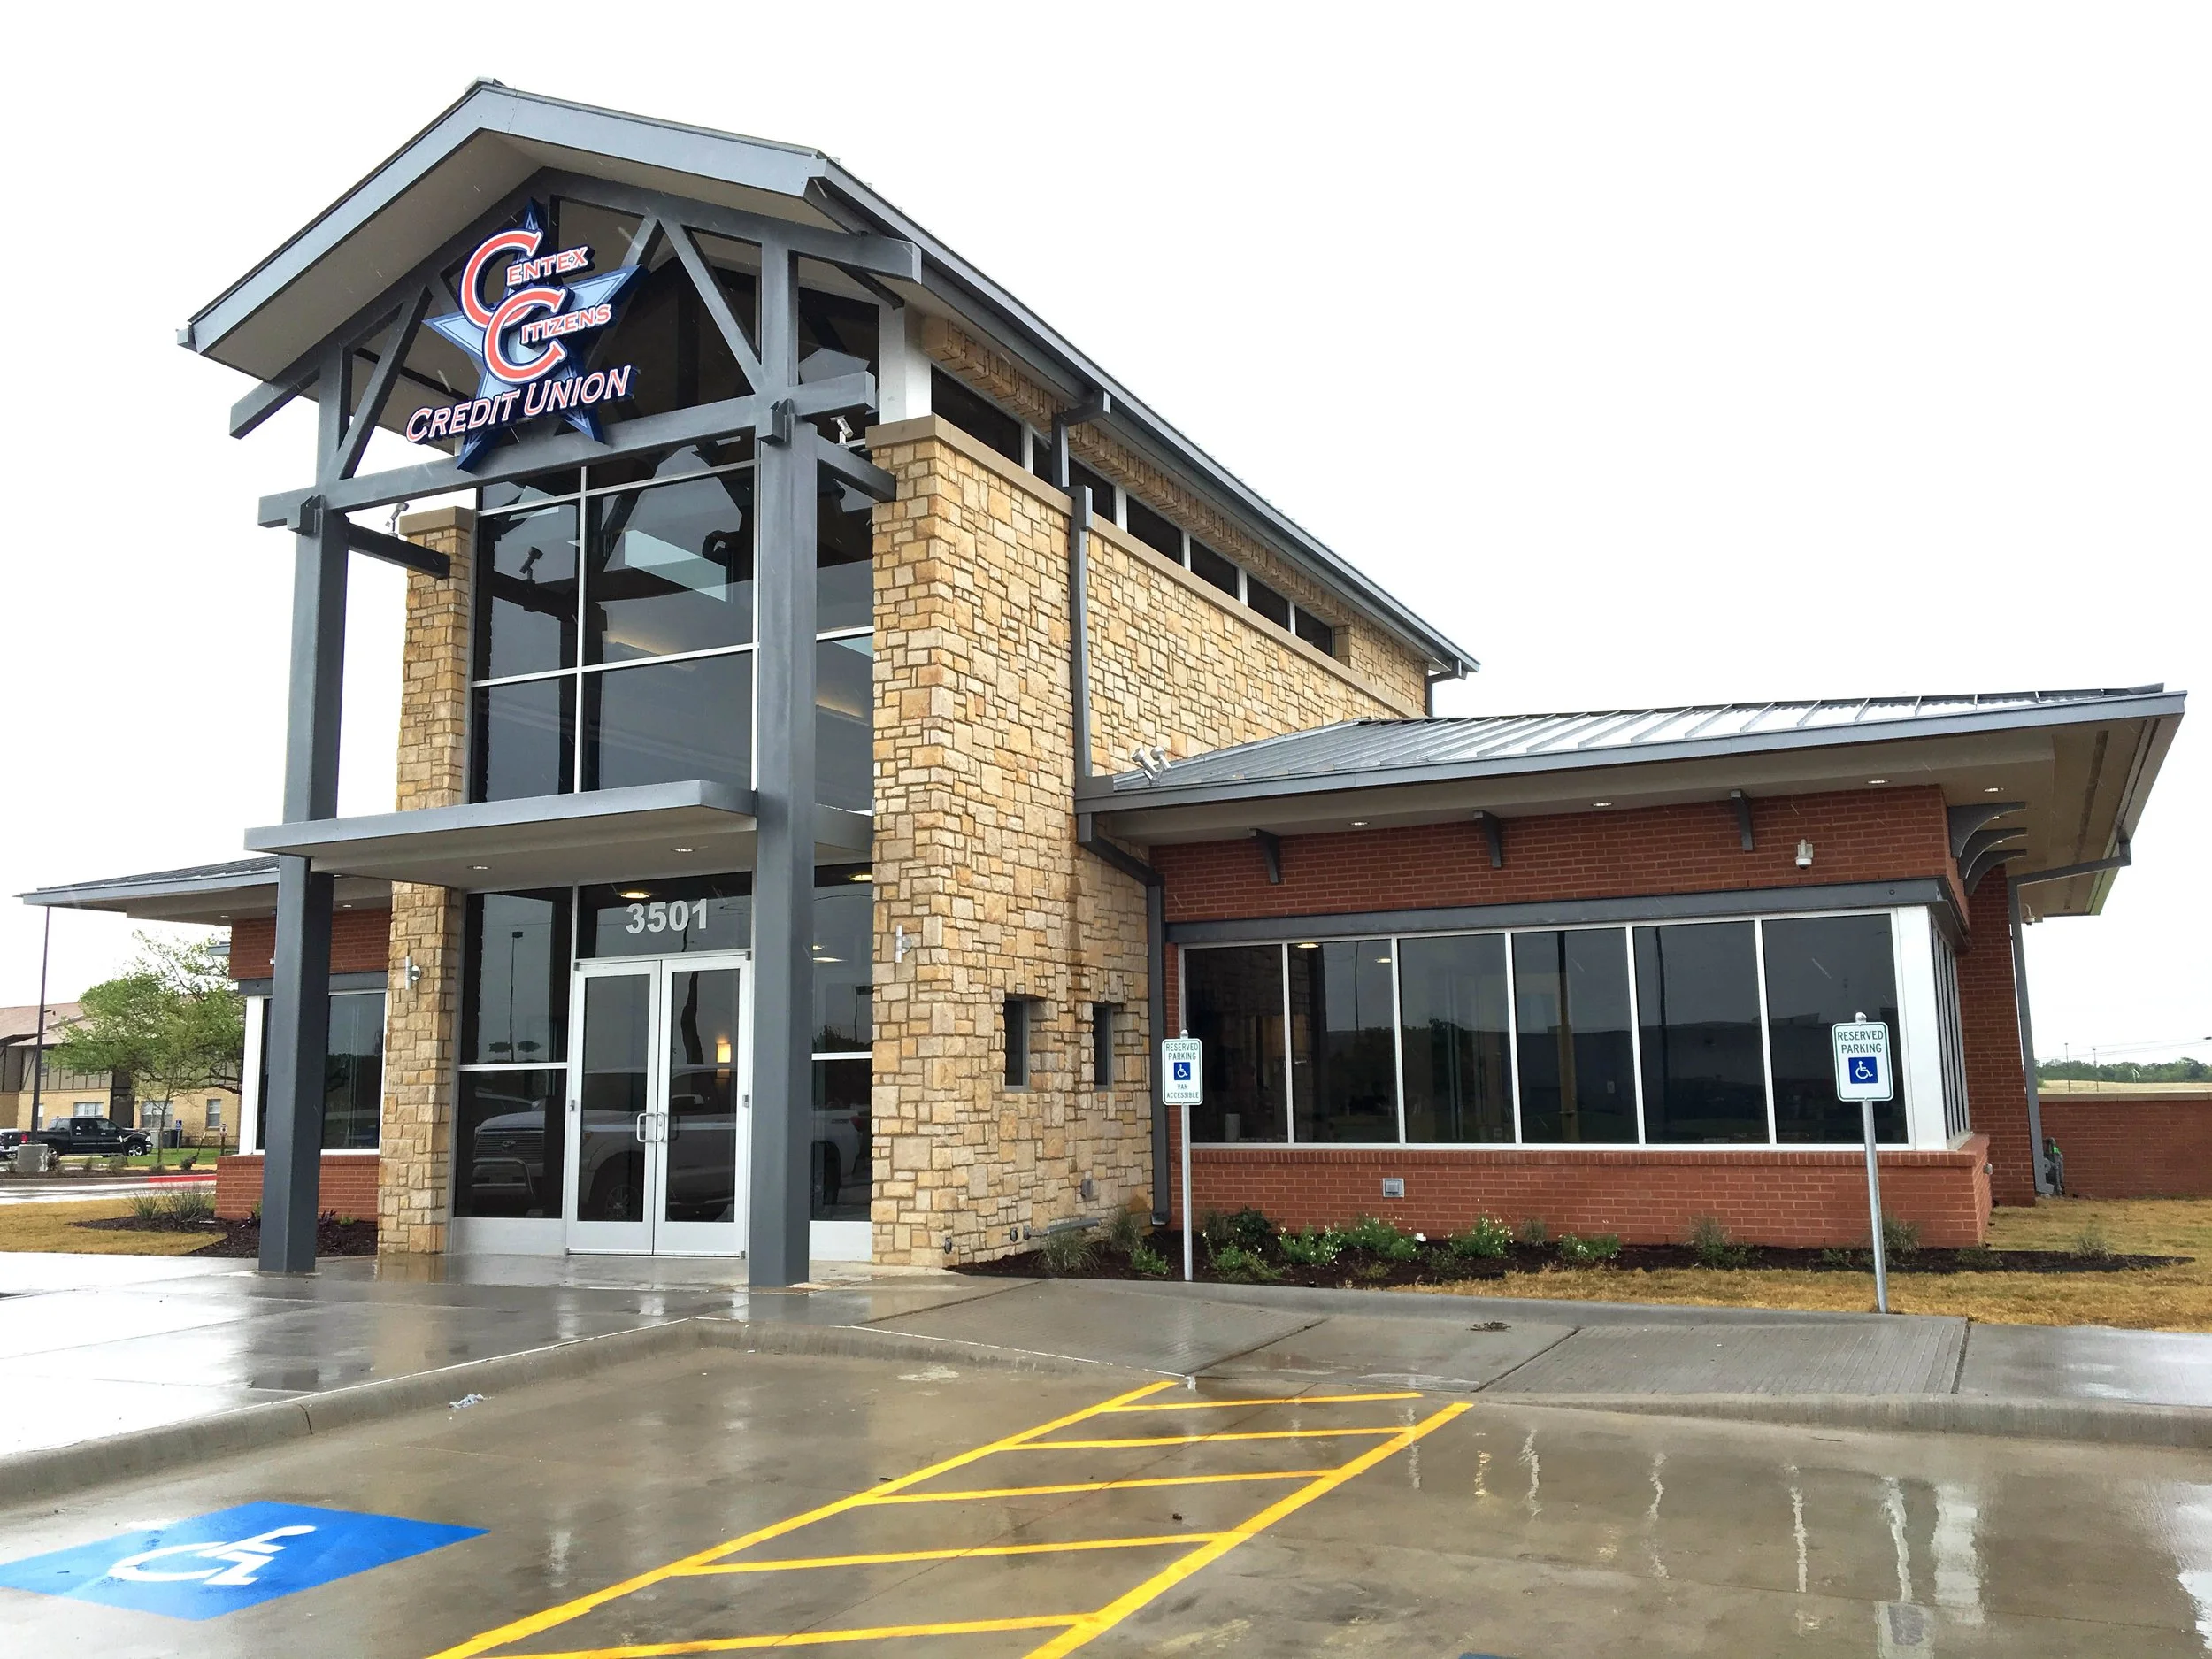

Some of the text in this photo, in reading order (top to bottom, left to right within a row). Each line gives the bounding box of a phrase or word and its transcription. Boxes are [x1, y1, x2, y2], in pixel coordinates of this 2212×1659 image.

[483, 285, 612, 384] CITIZENS
[405, 365, 632, 442] CREDIT UNION
[626, 898, 707, 934] 3501
[1837, 1030, 1884, 1041] RESERVED
[1165, 1043, 1199, 1052] RESERVED
[1841, 1043, 1882, 1054] PARKING
[1168, 1052, 1196, 1061] PARKING
